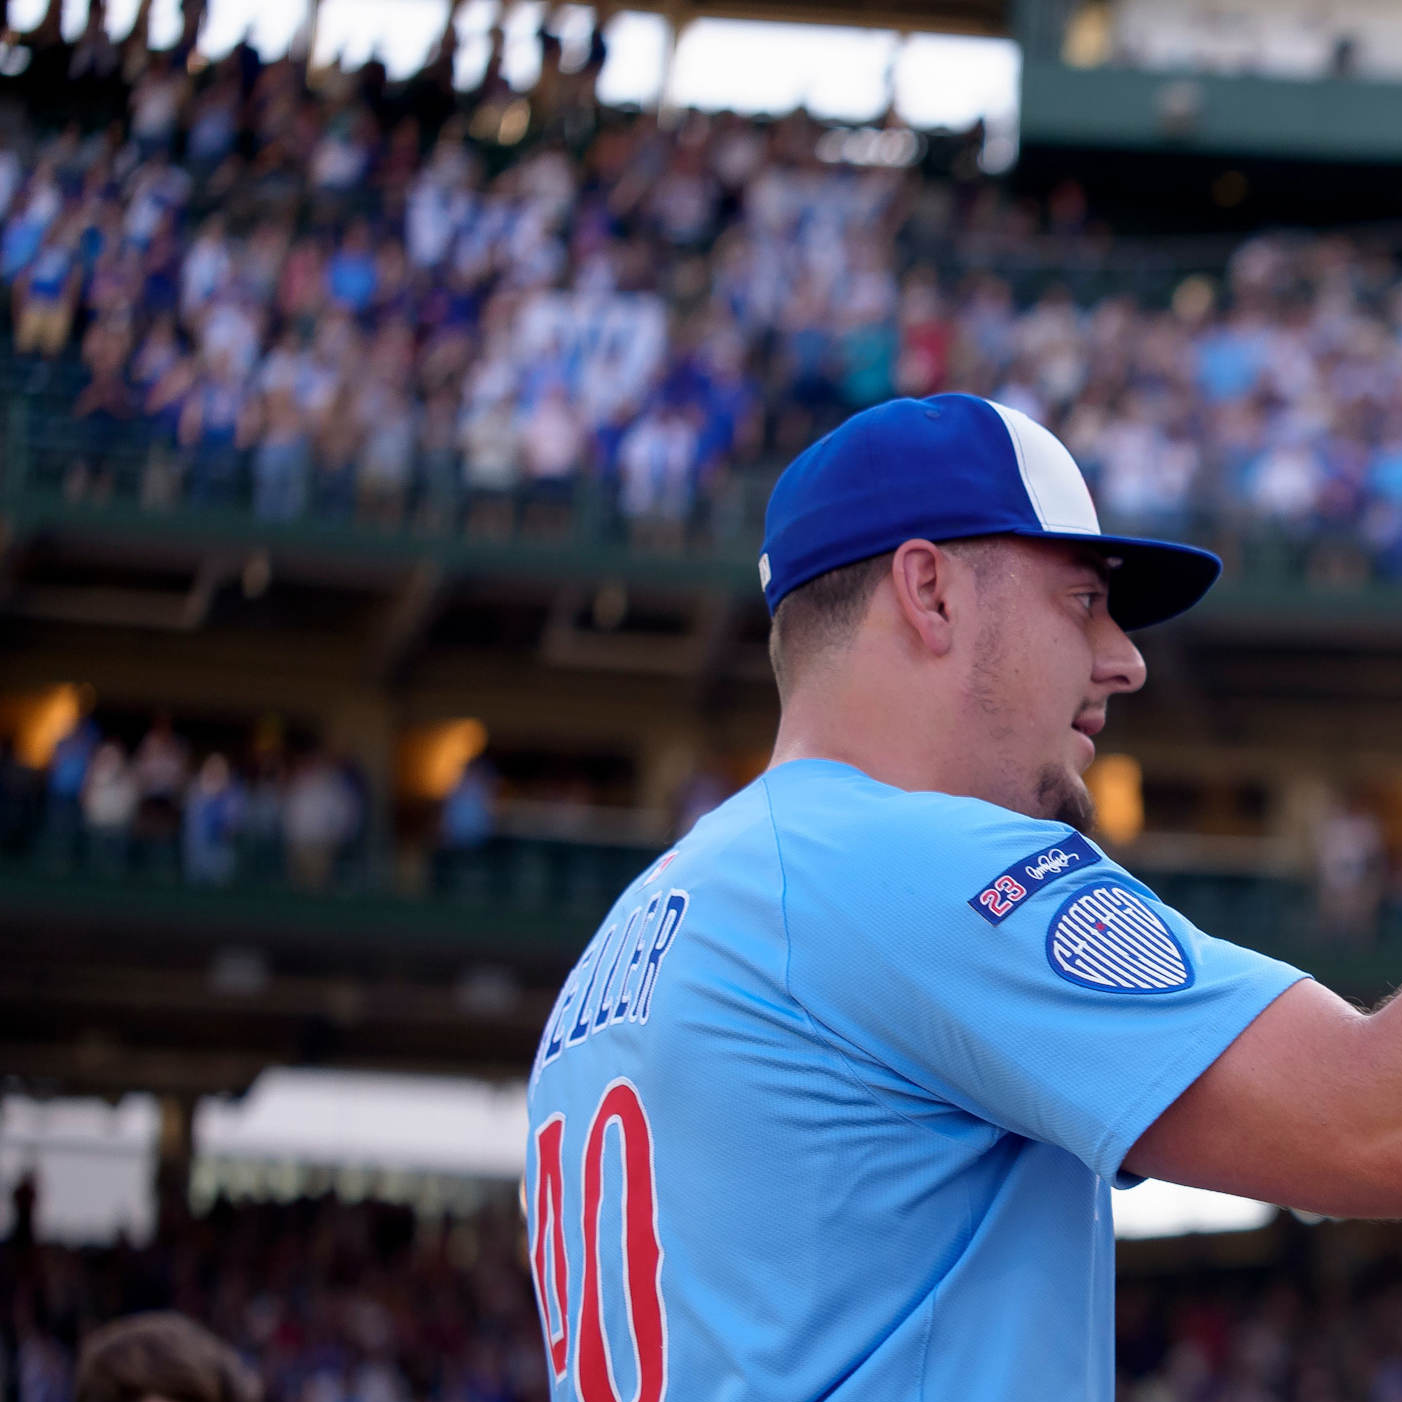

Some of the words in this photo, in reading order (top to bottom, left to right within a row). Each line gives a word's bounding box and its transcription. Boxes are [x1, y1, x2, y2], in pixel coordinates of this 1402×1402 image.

[979, 875, 1027, 917] 23
[1053, 887, 1188, 990] CHICAGO
[534, 888, 690, 1074] ELLER
